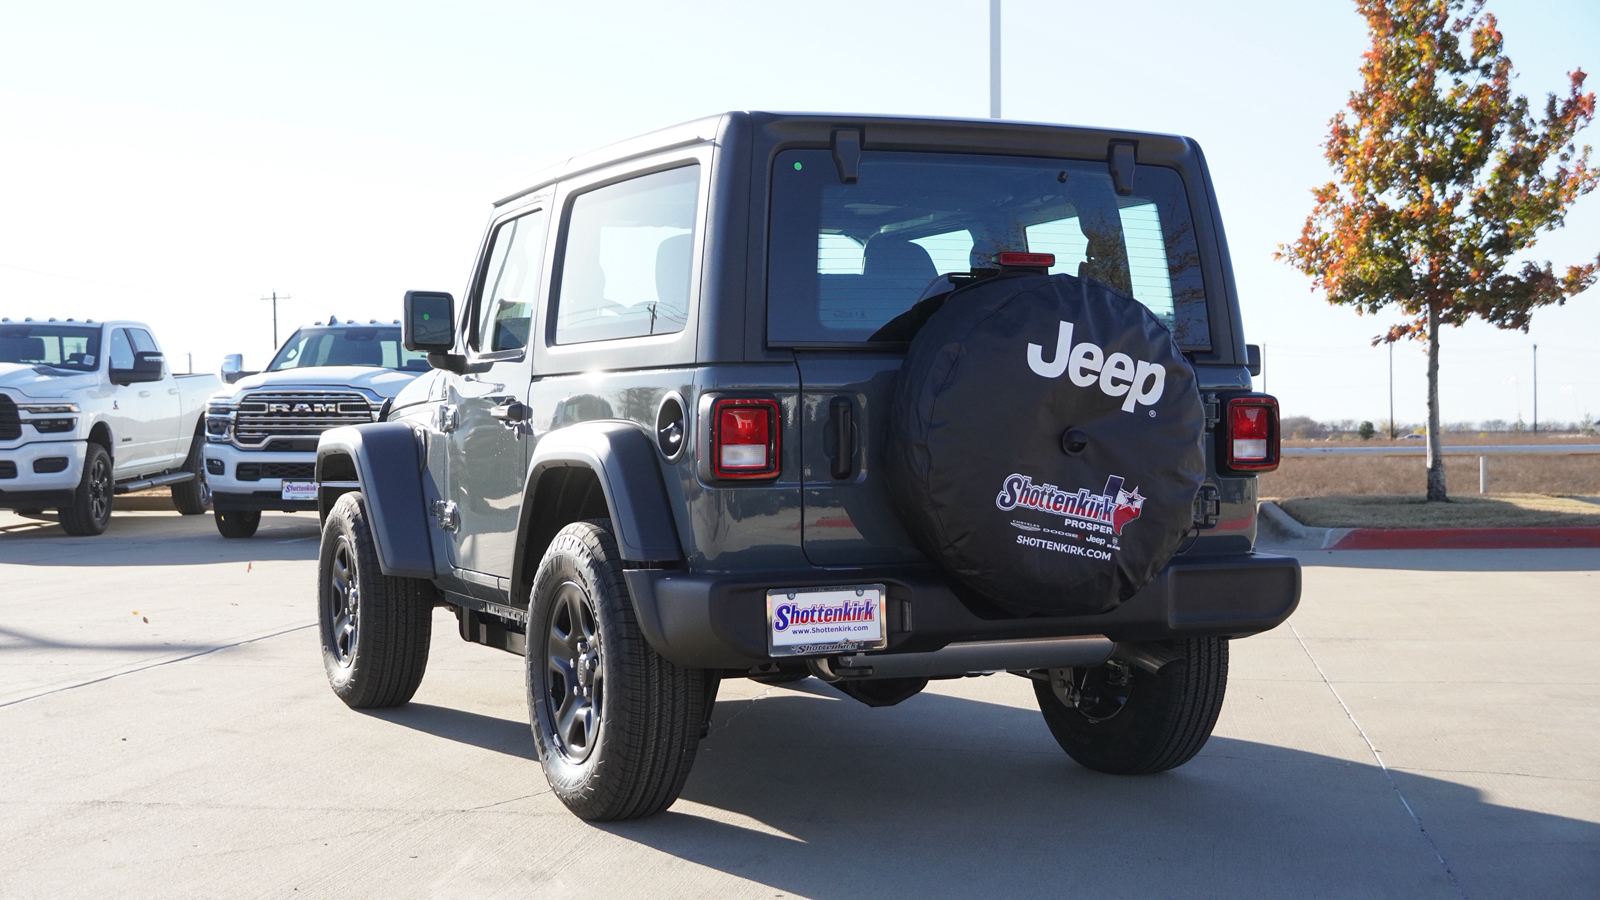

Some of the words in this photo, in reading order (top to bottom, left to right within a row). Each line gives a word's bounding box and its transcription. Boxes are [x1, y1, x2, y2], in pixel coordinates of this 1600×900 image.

[1026, 320, 1167, 414] Jeep
[269, 403, 336, 412] RAM
[996, 473, 1115, 524] Shottenkirk
[1064, 518, 1113, 535] PROSPER
[1042, 527, 1079, 539] DODGE
[1085, 534, 1106, 546] Jeep
[1016, 535, 1112, 561] SHOTTENKIRK.COM
[774, 599, 877, 632] Shottenkirk
[791, 624, 869, 635] www.Shottenkirk.com
[796, 641, 858, 655] Shottenkirk
